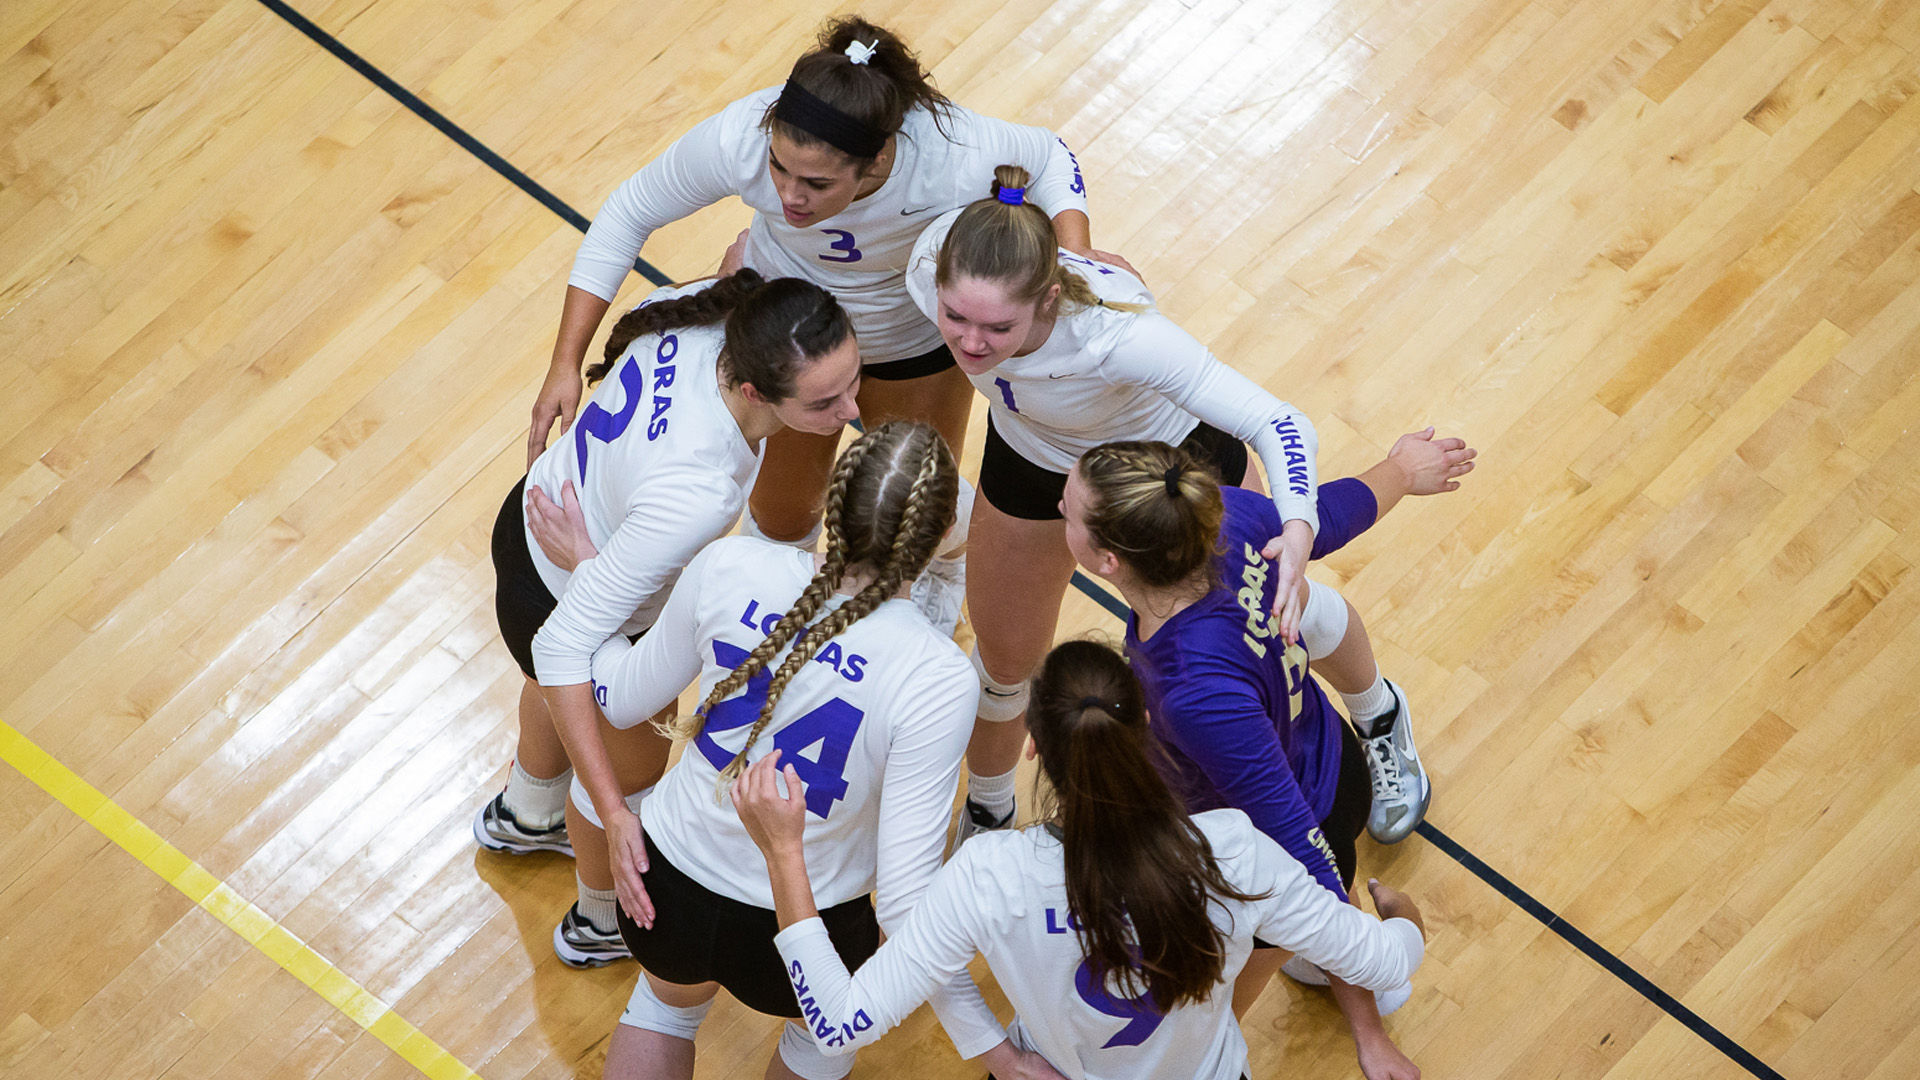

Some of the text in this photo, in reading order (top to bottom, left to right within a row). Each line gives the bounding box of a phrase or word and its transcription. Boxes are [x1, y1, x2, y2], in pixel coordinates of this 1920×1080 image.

[819, 229, 863, 263] 3
[575, 354, 643, 488] 2
[646, 328, 679, 442] ORAS
[994, 376, 1021, 414] 1
[692, 638, 865, 821] 24
[1074, 945, 1170, 1050] 9
